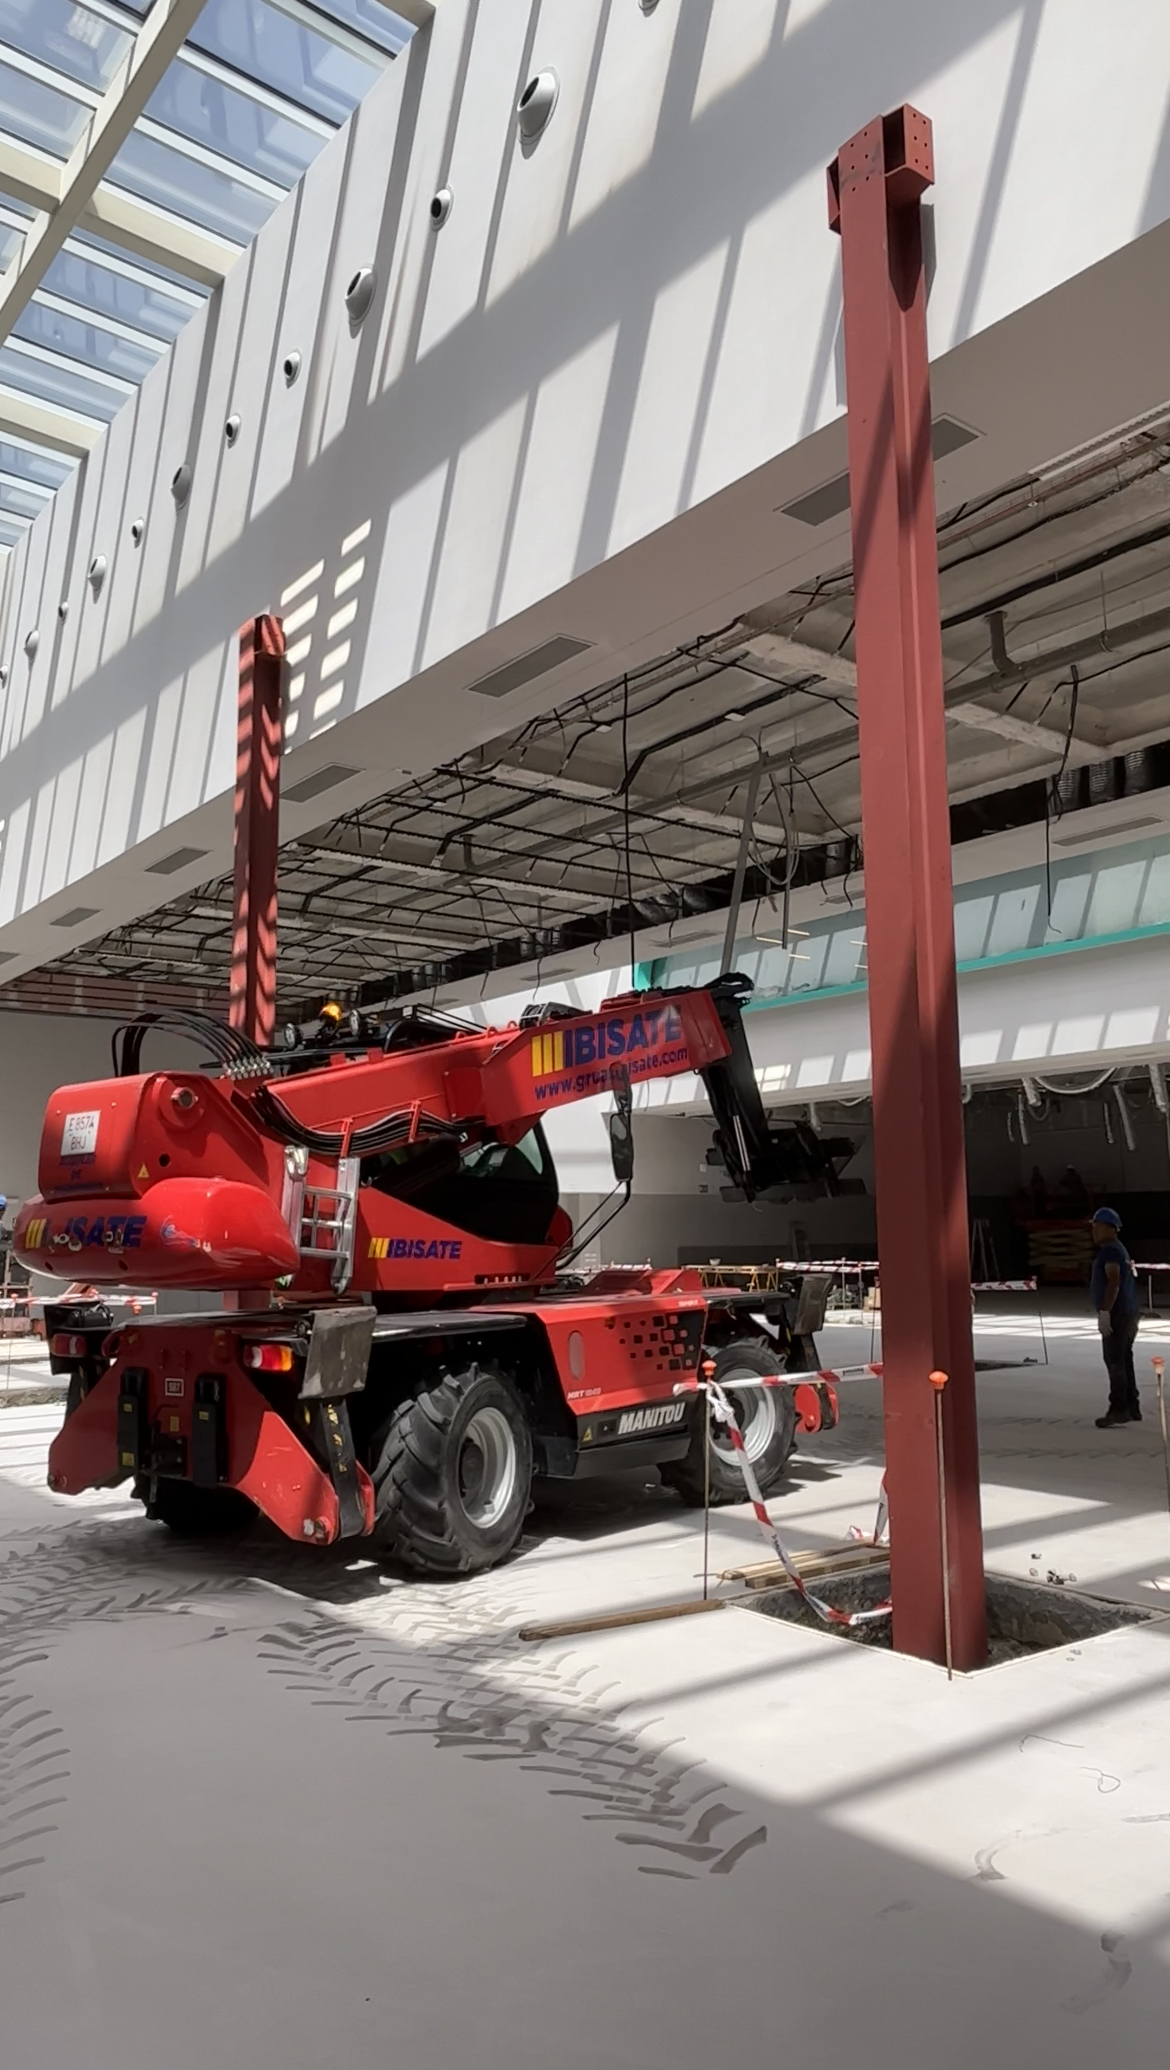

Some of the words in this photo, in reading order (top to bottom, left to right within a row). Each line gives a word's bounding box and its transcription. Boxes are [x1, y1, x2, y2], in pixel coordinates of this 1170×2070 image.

[565, 1005, 681, 1068] IBISATE
[71, 1136, 87, 1150] BHJ
[386, 1238, 462, 1259] IBISATE
[618, 1402, 686, 1435] MANITOU
